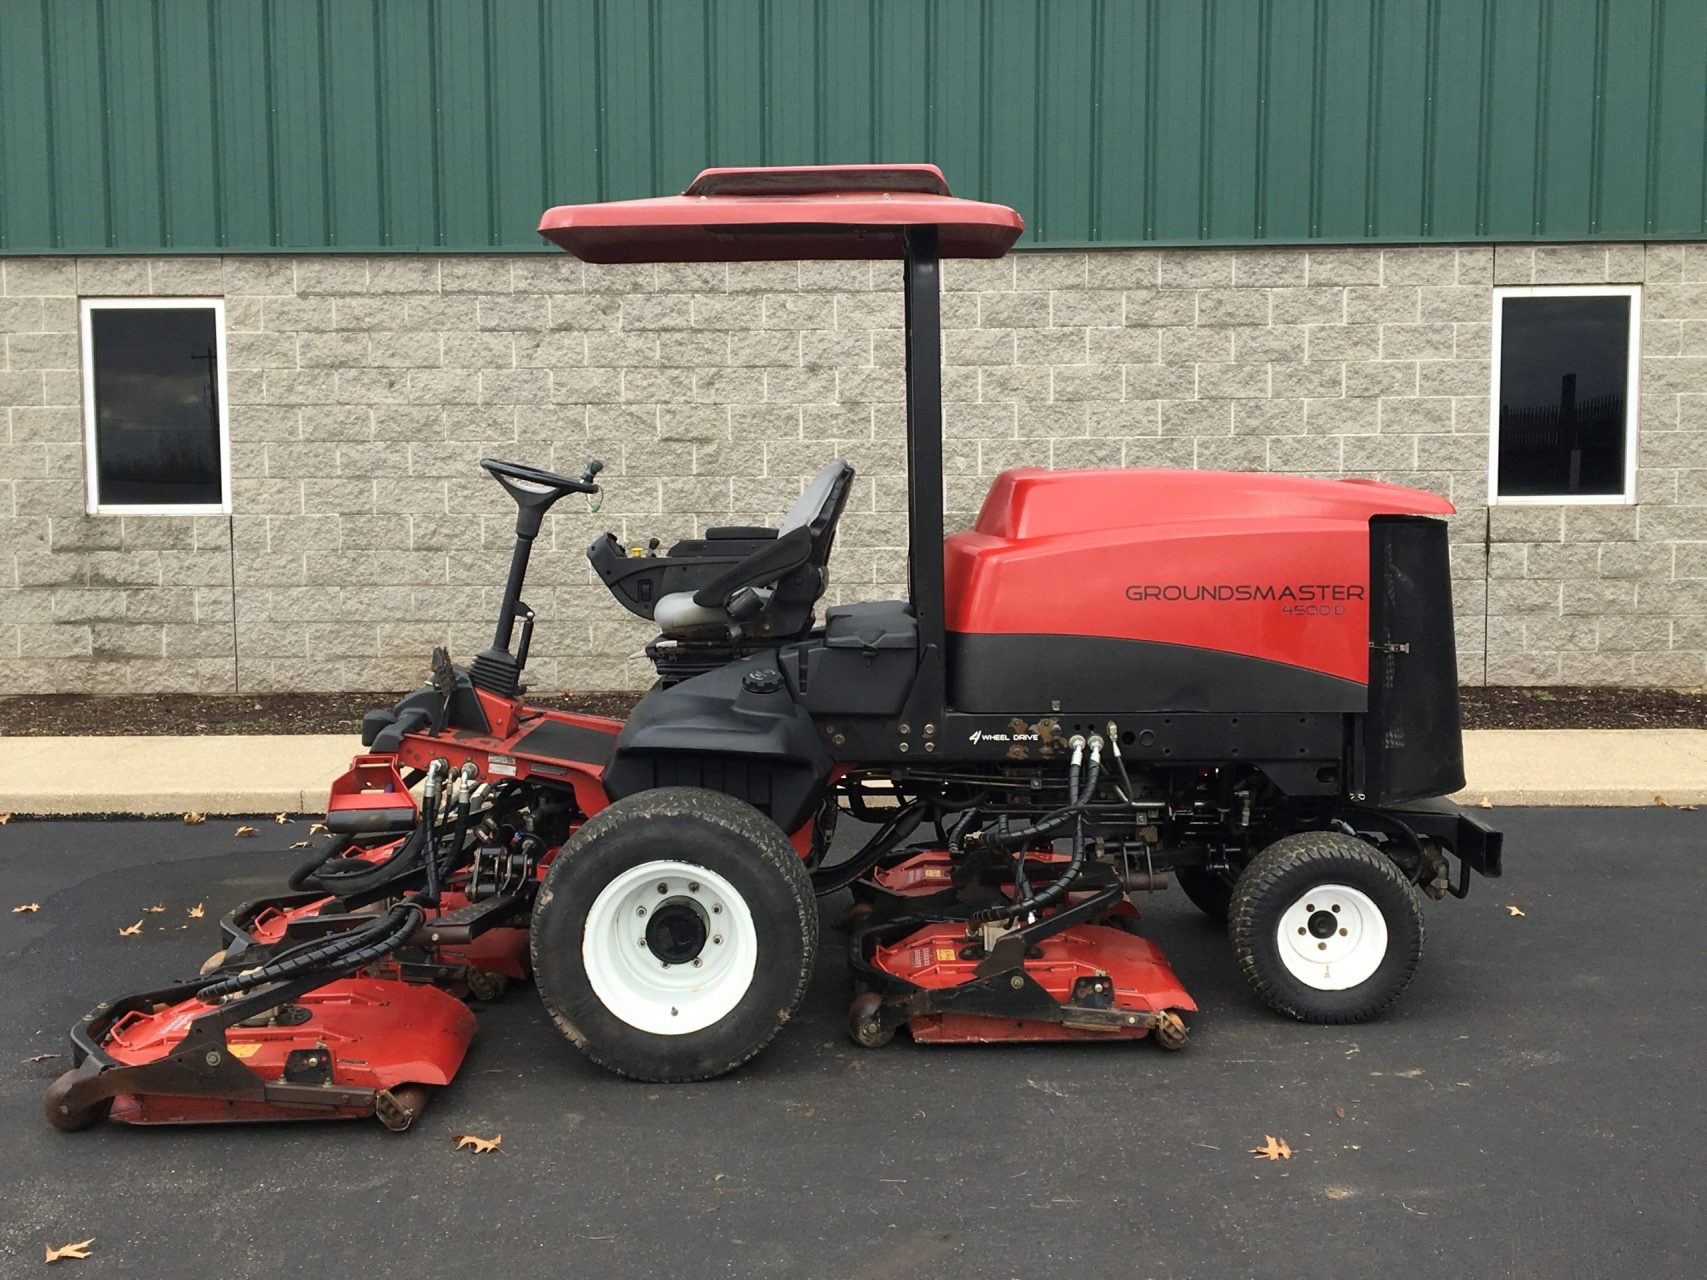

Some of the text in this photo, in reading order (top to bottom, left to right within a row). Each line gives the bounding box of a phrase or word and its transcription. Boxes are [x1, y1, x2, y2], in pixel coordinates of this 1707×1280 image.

[1125, 585, 1365, 601] GROUNDSMASTER
[1281, 603, 1345, 616] 4500 D
[968, 729, 982, 745] 4
